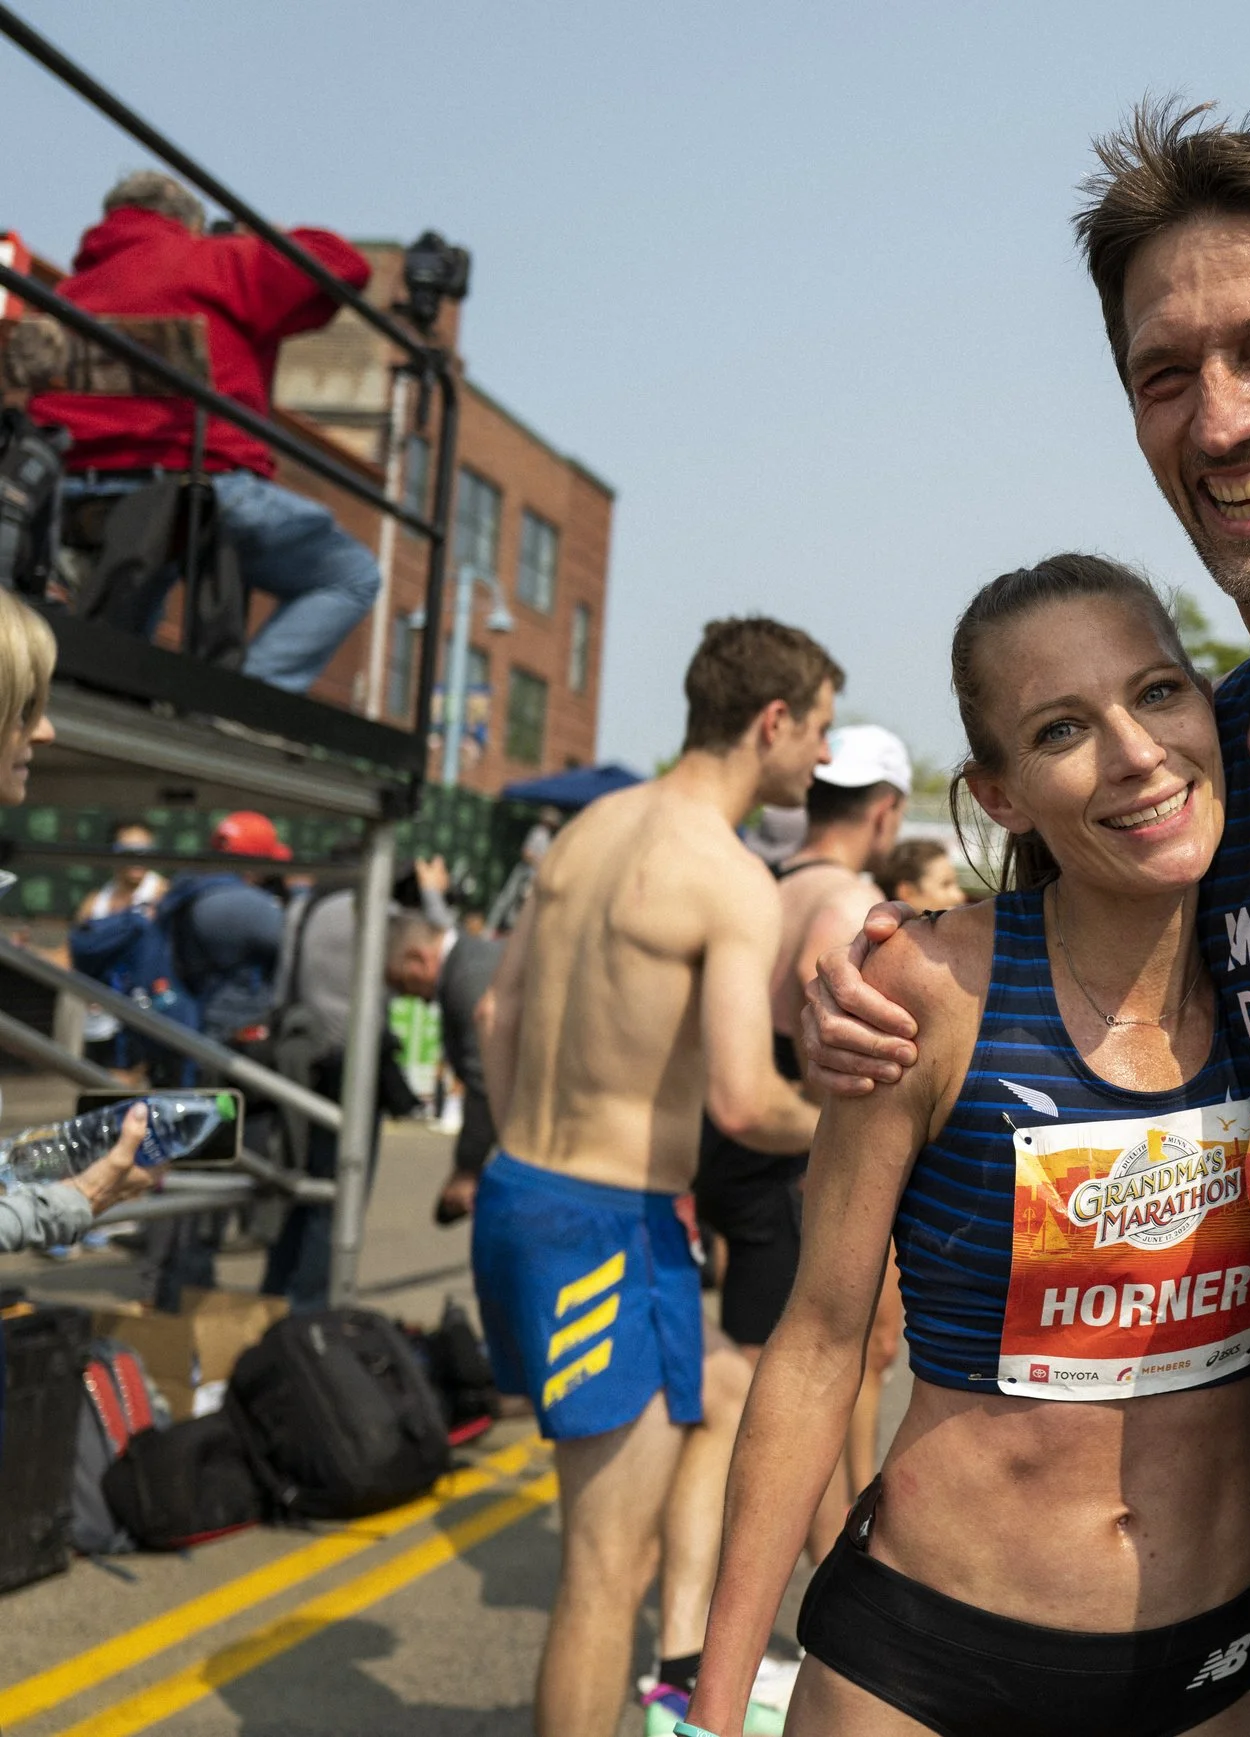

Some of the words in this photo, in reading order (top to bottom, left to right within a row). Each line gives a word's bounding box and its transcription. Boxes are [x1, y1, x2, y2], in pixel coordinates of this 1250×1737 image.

[1122, 1143, 1147, 1169] DULUTH
[1074, 1147, 1224, 1220] GRANDMA'S
[1099, 1170, 1240, 1243] MARATHON
[1142, 1235, 1163, 1243] JUNE
[1054, 1370, 1099, 1381] TOYOTA
[1142, 1359, 1191, 1375] MEMBERS
